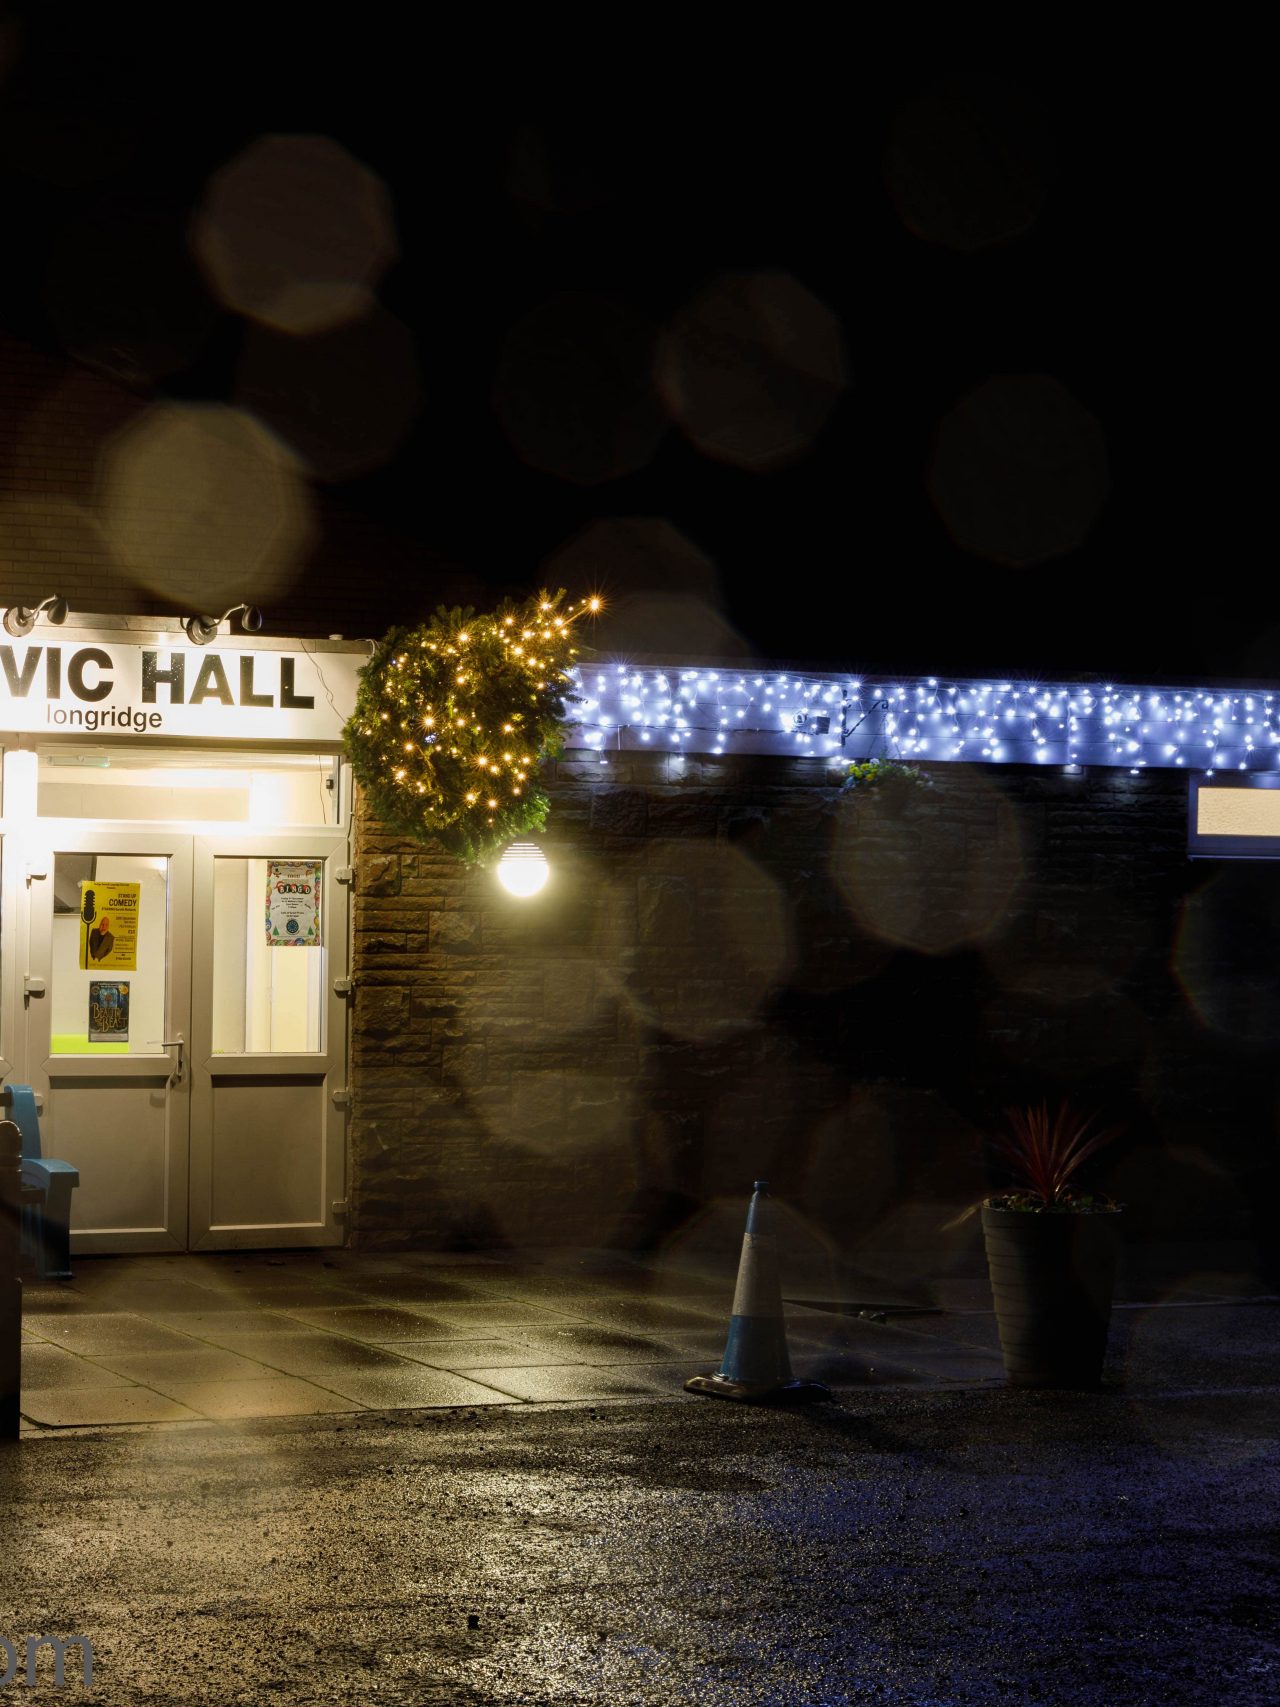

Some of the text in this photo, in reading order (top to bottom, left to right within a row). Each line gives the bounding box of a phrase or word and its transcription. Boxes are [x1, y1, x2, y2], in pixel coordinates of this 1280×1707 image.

[141, 650, 315, 709] HALL
[47, 703, 163, 733] longridge
[279, 885, 311, 894] BINGO
[109, 898, 137, 907] COMEDY
[91, 1003, 123, 1019] BEAUTY
